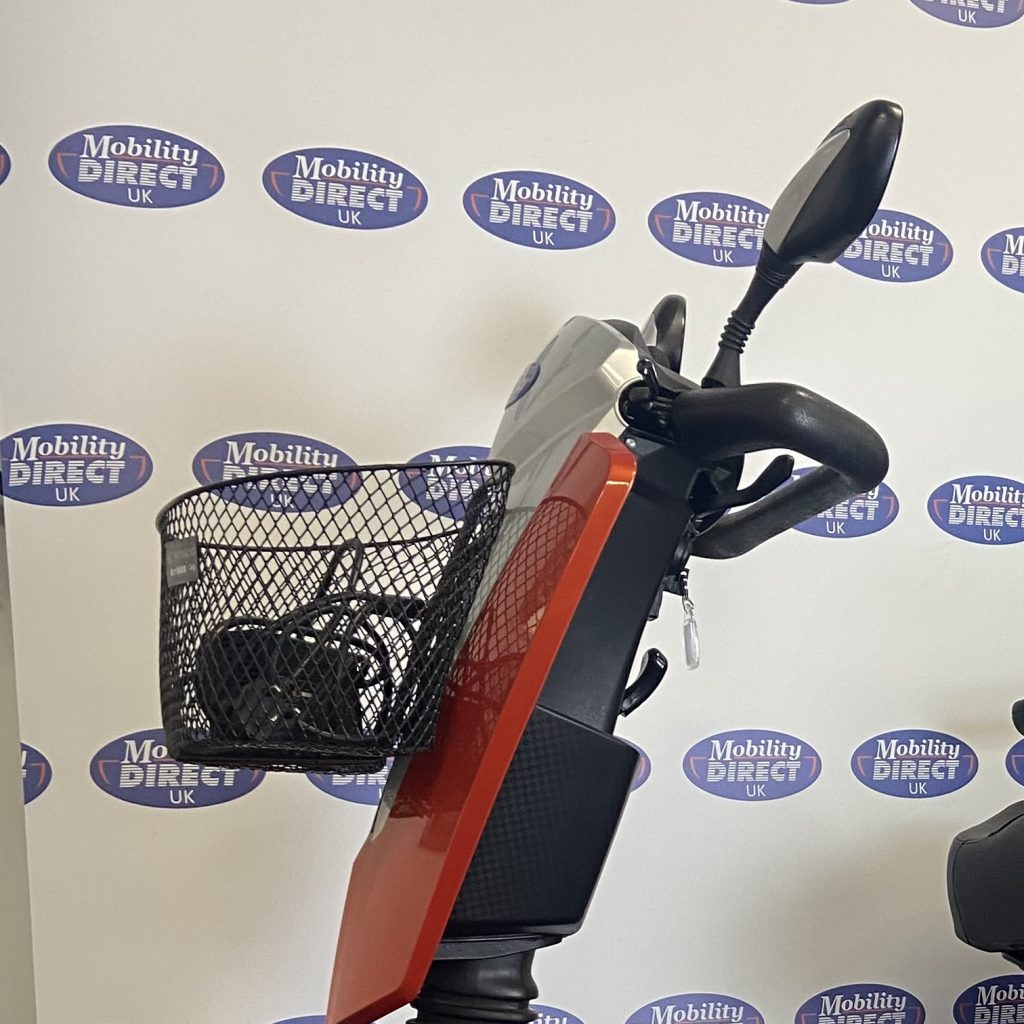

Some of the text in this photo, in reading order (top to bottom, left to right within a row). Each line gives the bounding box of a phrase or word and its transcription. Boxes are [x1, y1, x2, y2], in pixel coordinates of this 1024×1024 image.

[958, 8, 977, 24] UK
[79, 133, 198, 166] Mobility
[77, 158, 198, 190] DIRECT
[291, 155, 404, 189] Mobility
[127, 187, 153, 204] UK
[290, 178, 403, 213] DIRECT
[490, 178, 593, 209] Mobility
[337, 207, 362, 225] UK
[489, 201, 593, 233] DIRECT
[673, 199, 770, 229] Mobility
[532, 229, 555, 246] UK
[860, 219, 934, 245] obility
[712, 248, 733, 263] UK
[843, 239, 934, 266] DIRECT
[881, 263, 900, 278] UK
[10, 434, 126, 463] Mobility
[223, 440, 338, 468] Mobility
[9, 459, 126, 487] DIRECT
[55, 486, 80, 502] UK
[270, 493, 294, 509] UK
[826, 520, 845, 535] UK
[982, 528, 1001, 541] UK
[708, 739, 802, 761] Mobility
[875, 738, 961, 760] Mobility
[119, 763, 240, 788] DIRECT
[706, 760, 801, 782] DIRECT
[872, 758, 960, 780] DIRECT
[169, 789, 195, 804] UK
[746, 784, 767, 798] UK
[908, 781, 927, 795] UK
[818, 991, 906, 1017] Mobility
